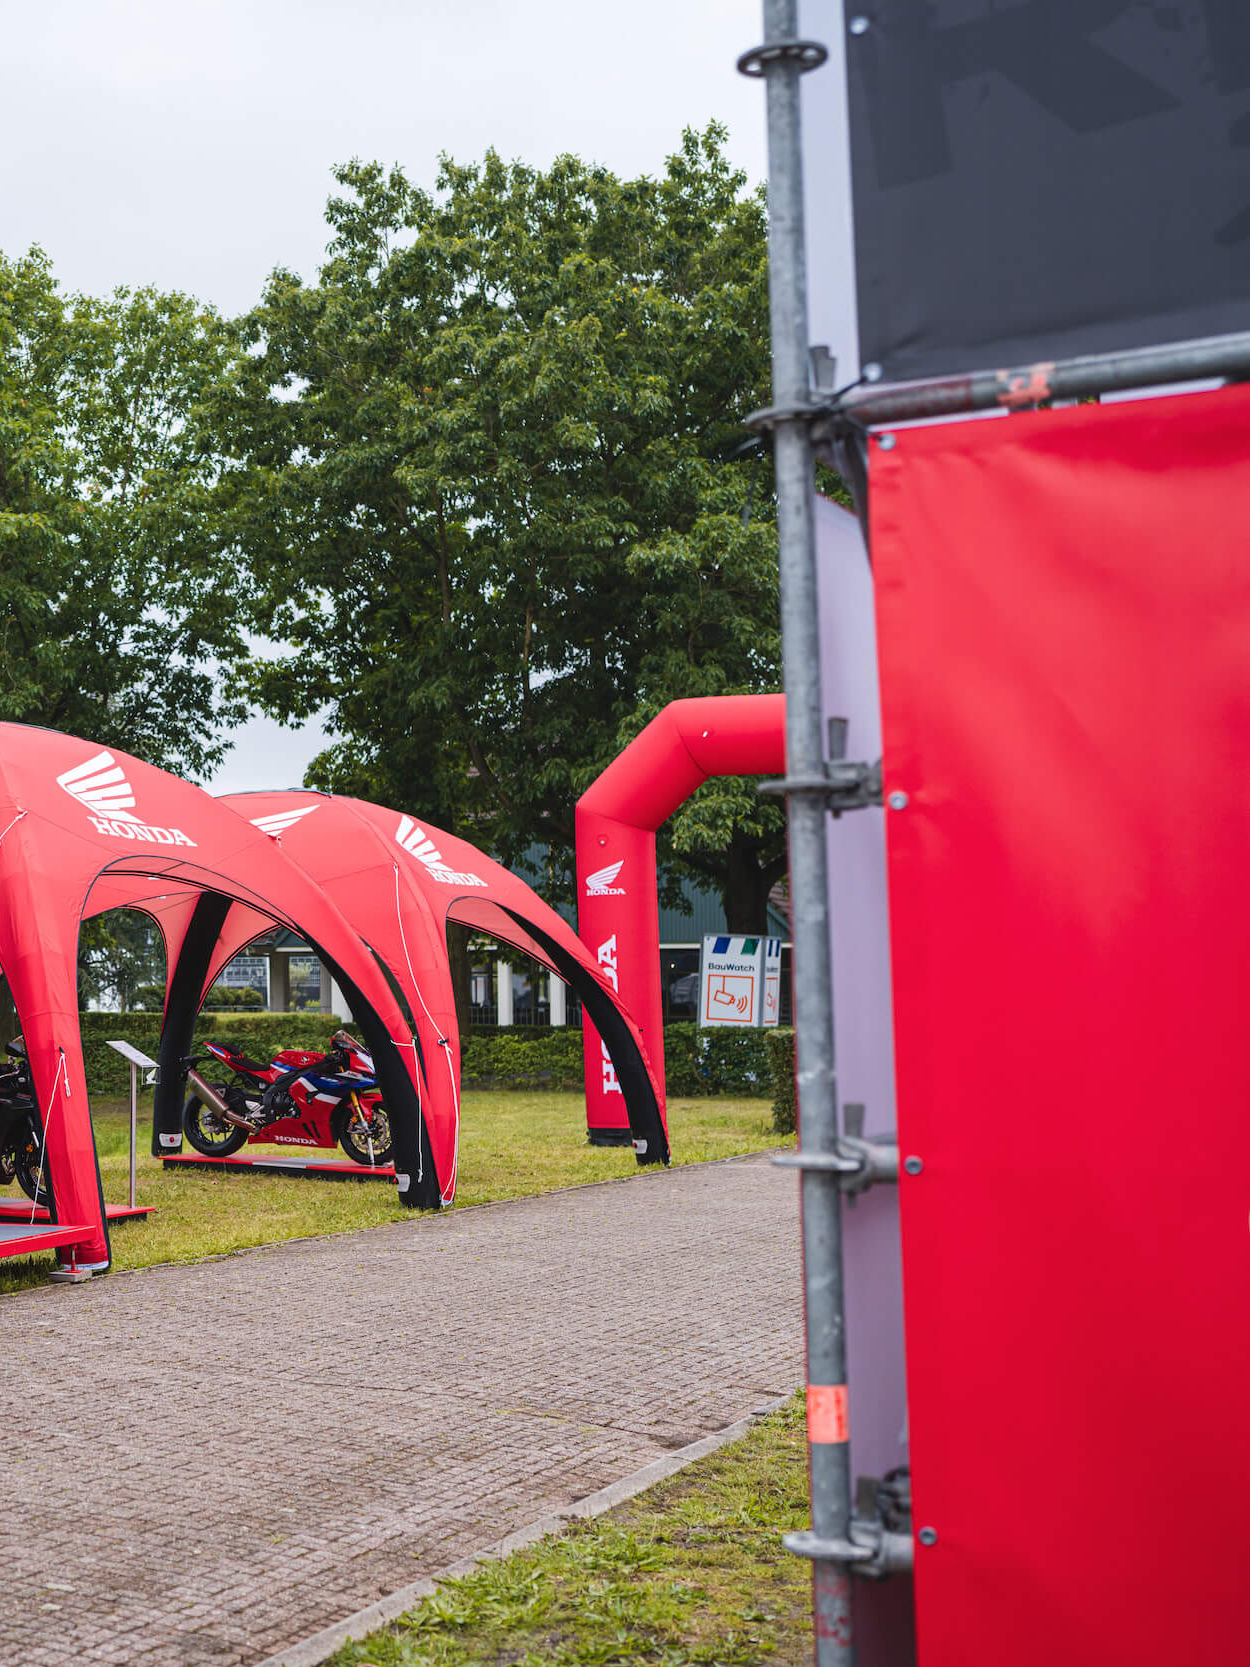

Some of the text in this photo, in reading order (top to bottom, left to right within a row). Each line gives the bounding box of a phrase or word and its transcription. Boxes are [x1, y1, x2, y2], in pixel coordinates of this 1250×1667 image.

[86, 816, 198, 847] HONDA
[425, 867, 488, 887] HONDA
[586, 888, 627, 896] HONDA
[708, 963, 755, 972] BauWatch
[275, 1136, 318, 1145] HONDA
